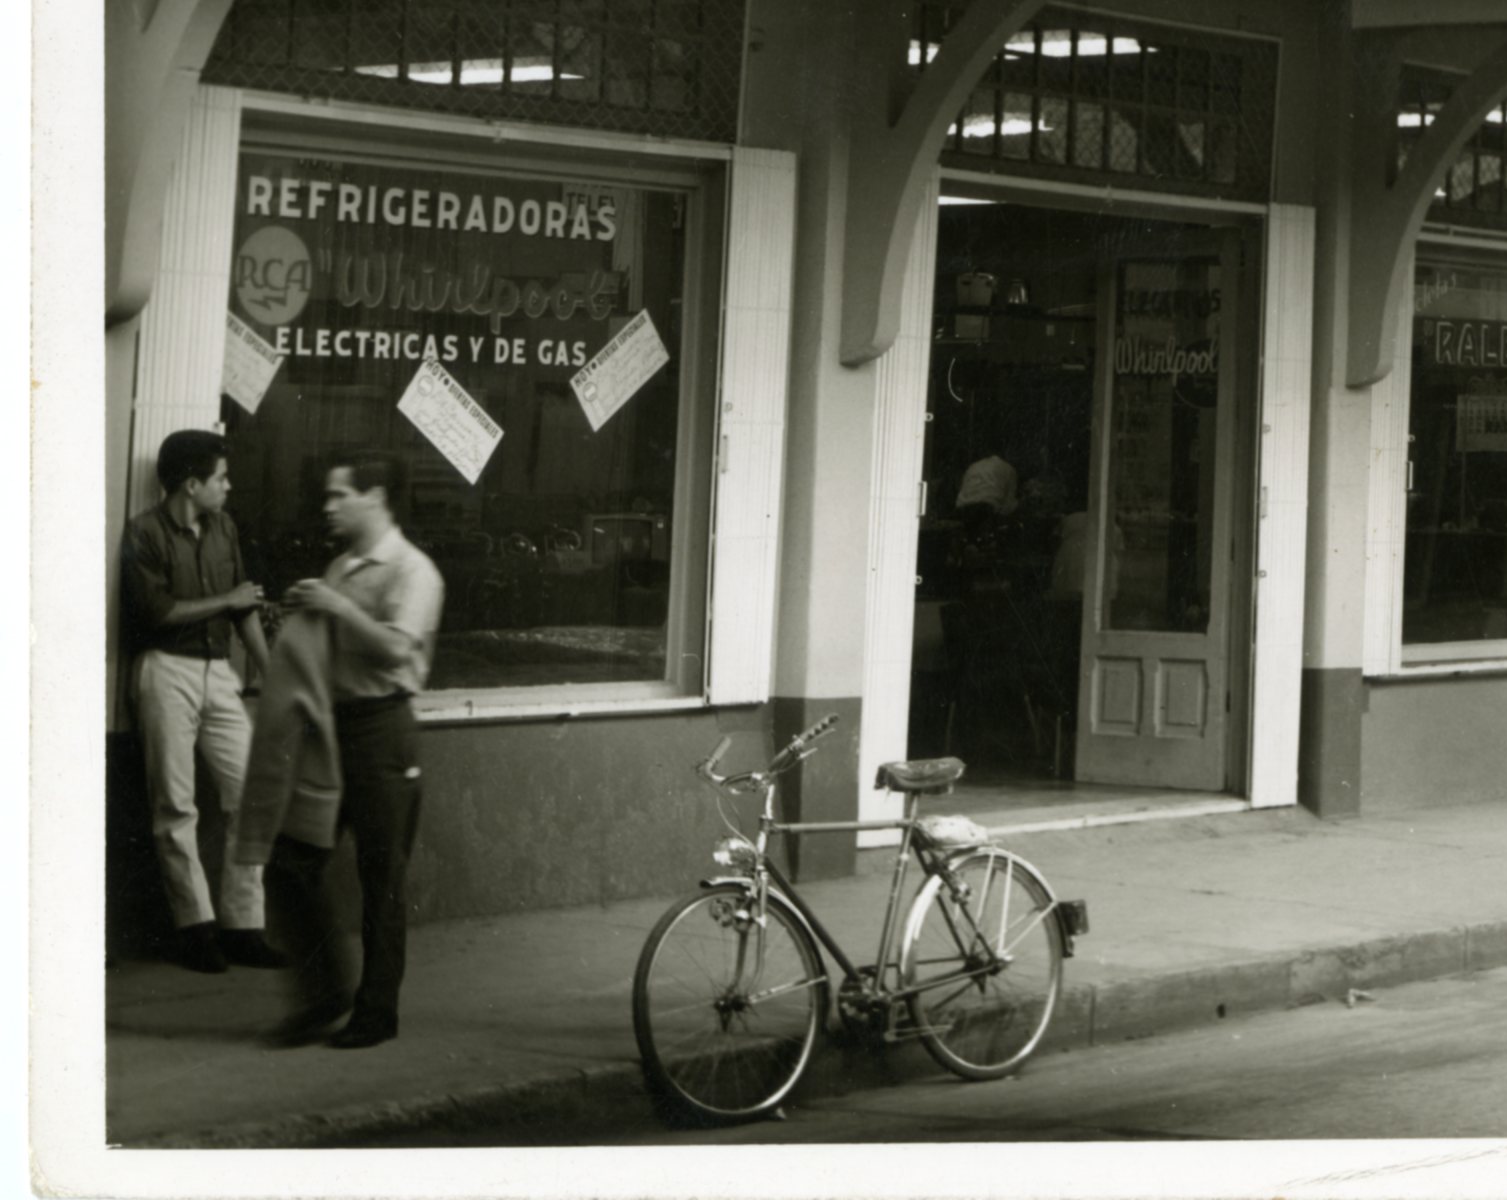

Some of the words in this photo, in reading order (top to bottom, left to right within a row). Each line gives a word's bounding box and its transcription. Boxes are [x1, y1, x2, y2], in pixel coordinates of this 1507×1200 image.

[247, 175, 618, 241] REFRIGERADORAS
[236, 254, 312, 294] RCA
[276, 327, 459, 362] ELECTRICAS
[469, 335, 484, 364] Y
[494, 338, 527, 366] DE
[537, 339, 587, 367] GAS
[1114, 336, 1219, 387] Whirlpool
